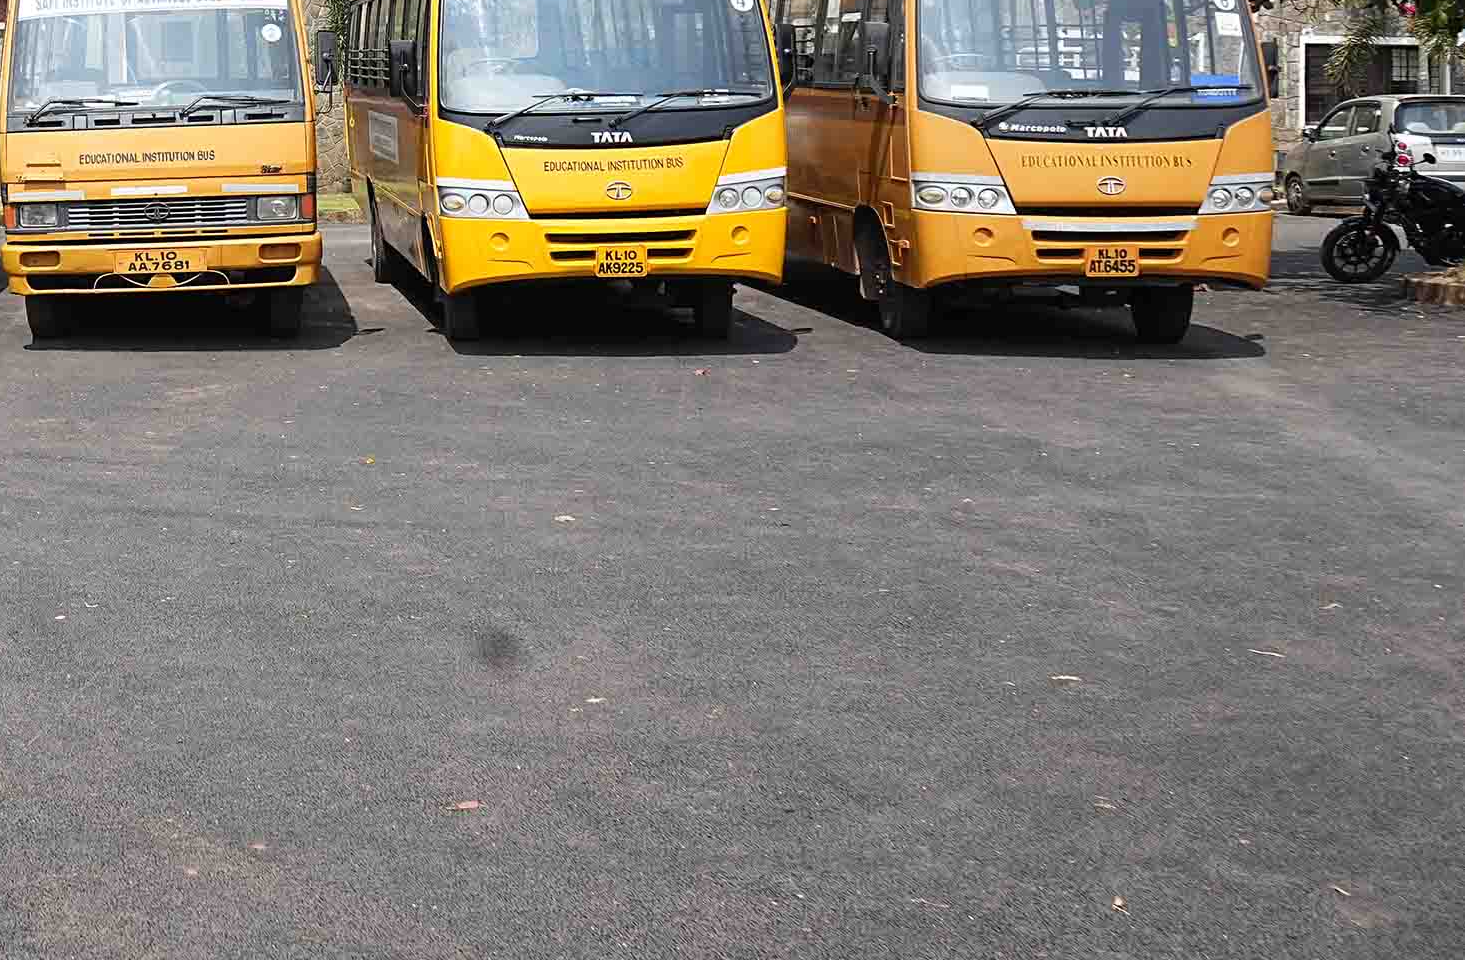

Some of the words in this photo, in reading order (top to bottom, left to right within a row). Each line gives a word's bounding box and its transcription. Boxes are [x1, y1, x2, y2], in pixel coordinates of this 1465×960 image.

[1010, 123, 1067, 133] Marcopolo
[1085, 126, 1128, 138] TATA
[591, 131, 634, 143] TATA
[79, 152, 140, 165] EDUCATIONAL
[142, 151, 195, 163] INSTITUTION
[197, 150, 216, 161] BUS
[1022, 155, 1097, 168] EDUCATIONAL
[1100, 155, 1171, 167] INSTITUTION
[1173, 155, 1192, 168] BUS
[543, 161, 604, 172] EDUCATIONAL
[607, 158, 664, 171] INSTITUTION
[666, 157, 684, 168] BUS
[128, 260, 190, 272] AA.7681
